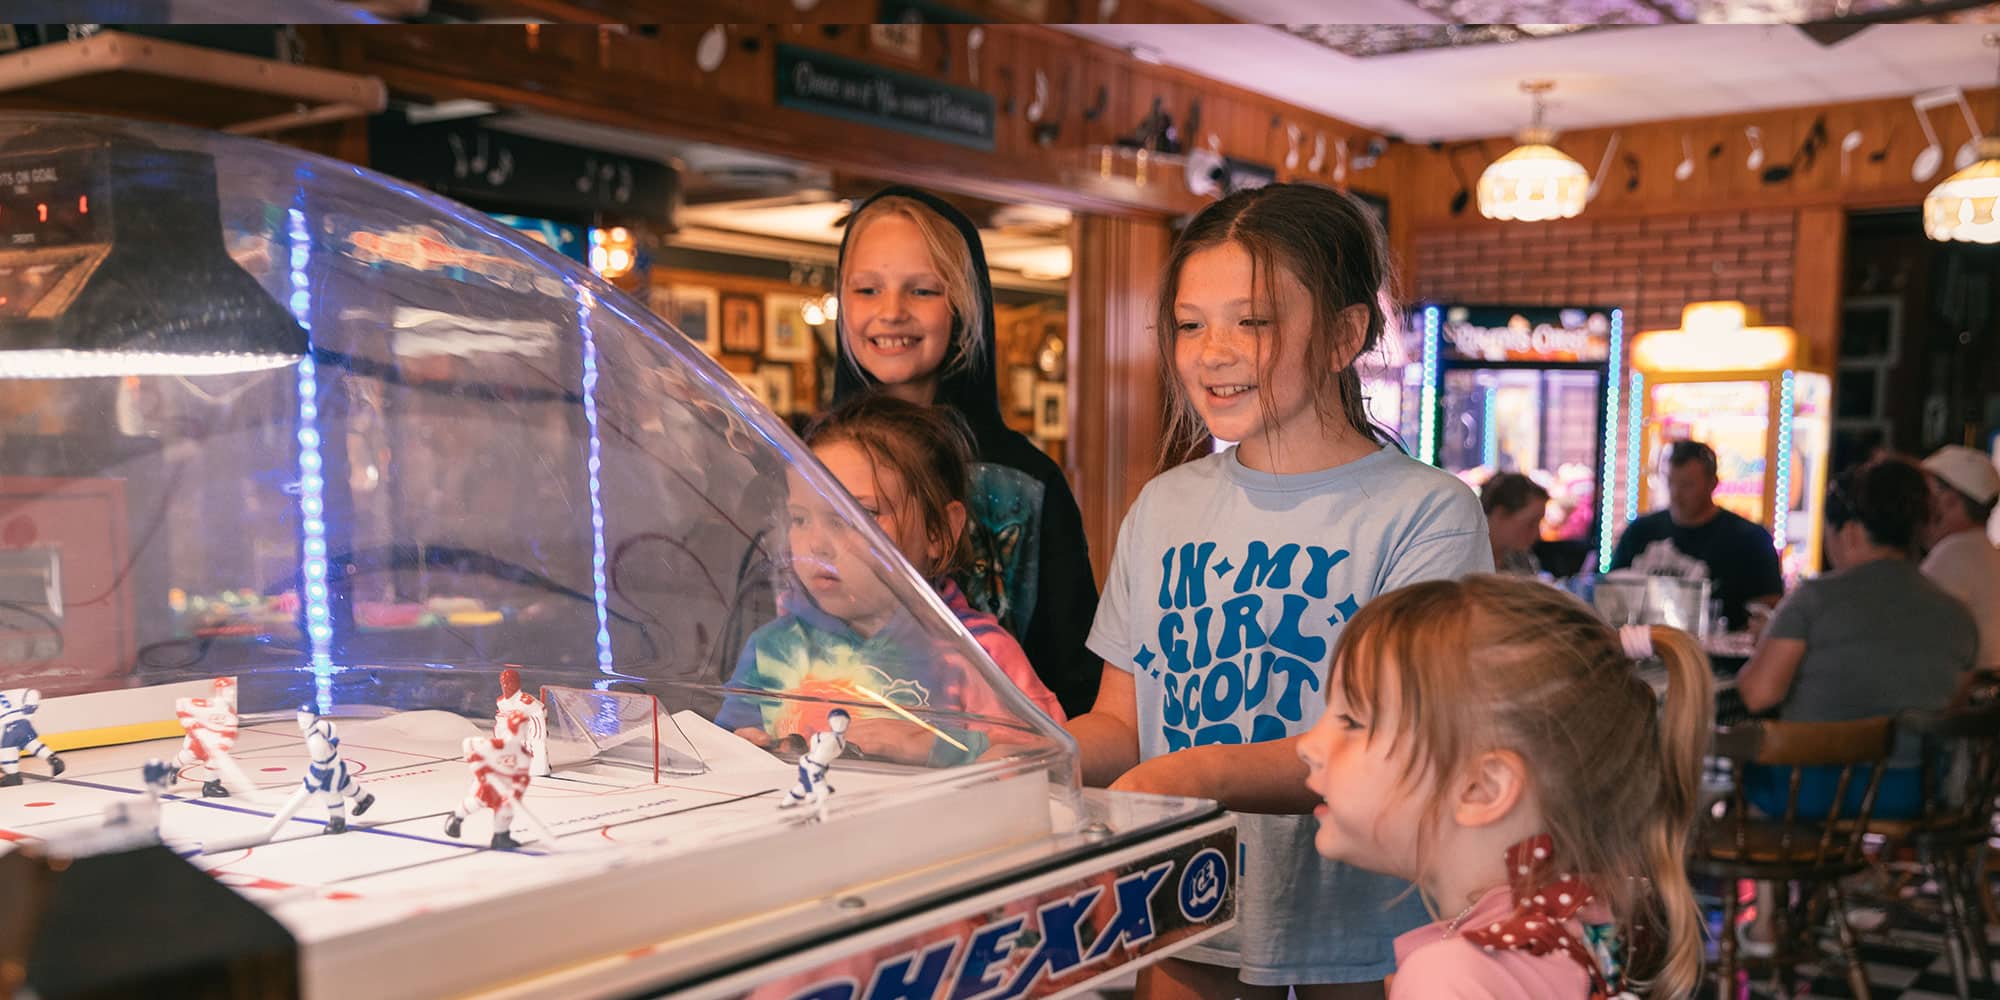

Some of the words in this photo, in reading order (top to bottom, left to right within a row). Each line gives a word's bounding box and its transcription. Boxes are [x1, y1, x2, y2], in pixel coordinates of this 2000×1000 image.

[32, 167, 58, 183] GOAL
[1158, 541, 1217, 610] IN
[1233, 540, 1350, 600] MY
[1158, 593, 1327, 673] GIRL
[1163, 651, 1320, 730] SCOUT
[785, 860, 1174, 1000] HEXX
